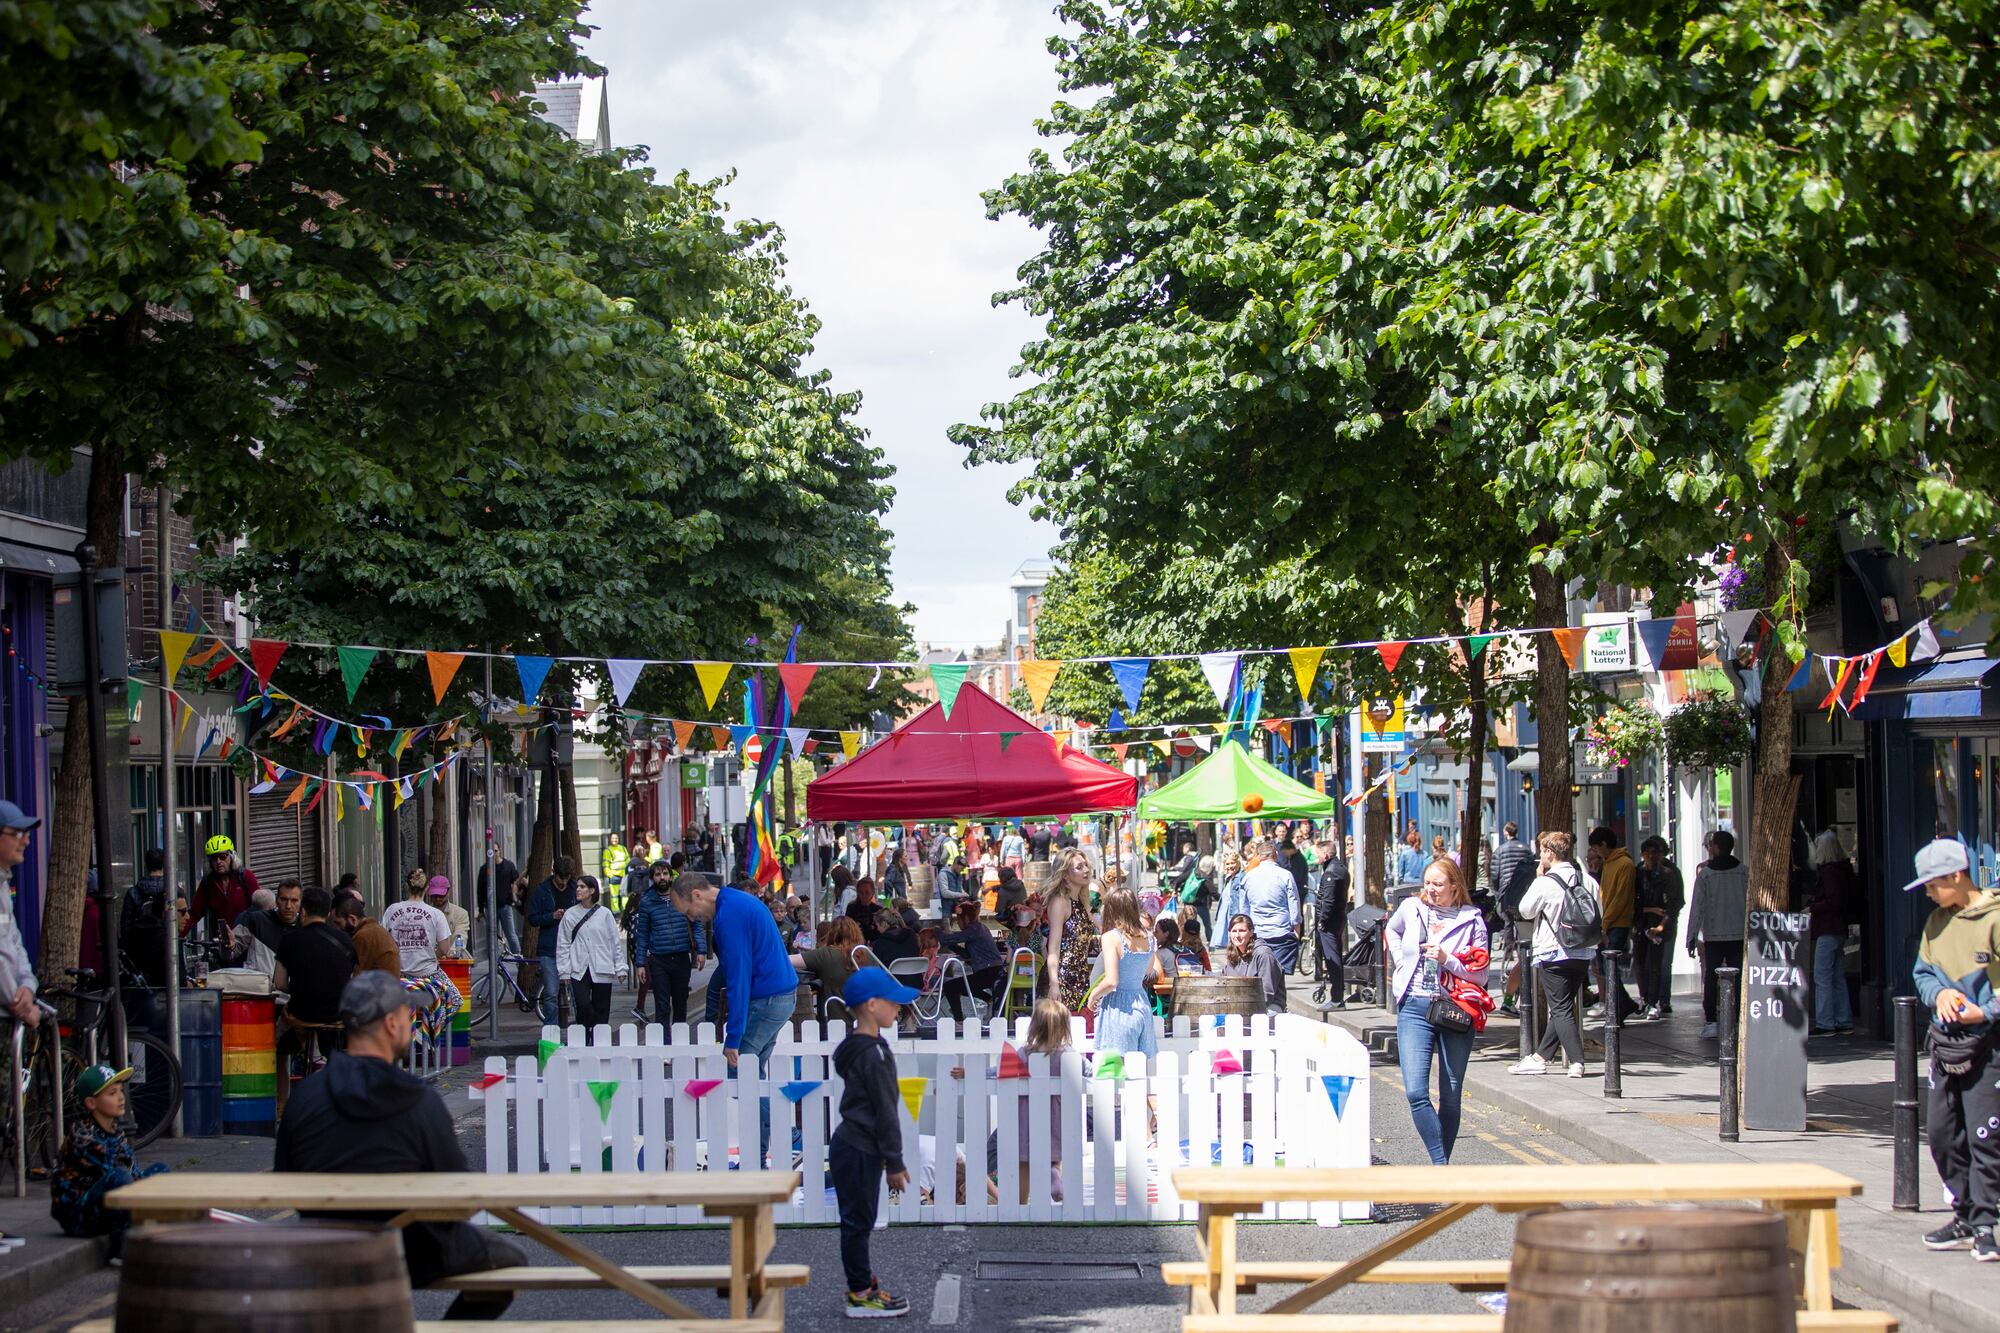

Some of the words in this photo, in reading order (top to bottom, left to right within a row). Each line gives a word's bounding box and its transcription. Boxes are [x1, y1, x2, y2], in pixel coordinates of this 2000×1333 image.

[1594, 656, 1625, 664] Lottery
[391, 908, 404, 921] THE
[406, 906, 431, 920] STONE
[1749, 911, 1811, 932] STONED
[1761, 941, 1799, 960] ANY
[1749, 966, 1801, 986] PIZZA
[1750, 1000, 1762, 1019] €
[1766, 998, 1783, 1018] 10
